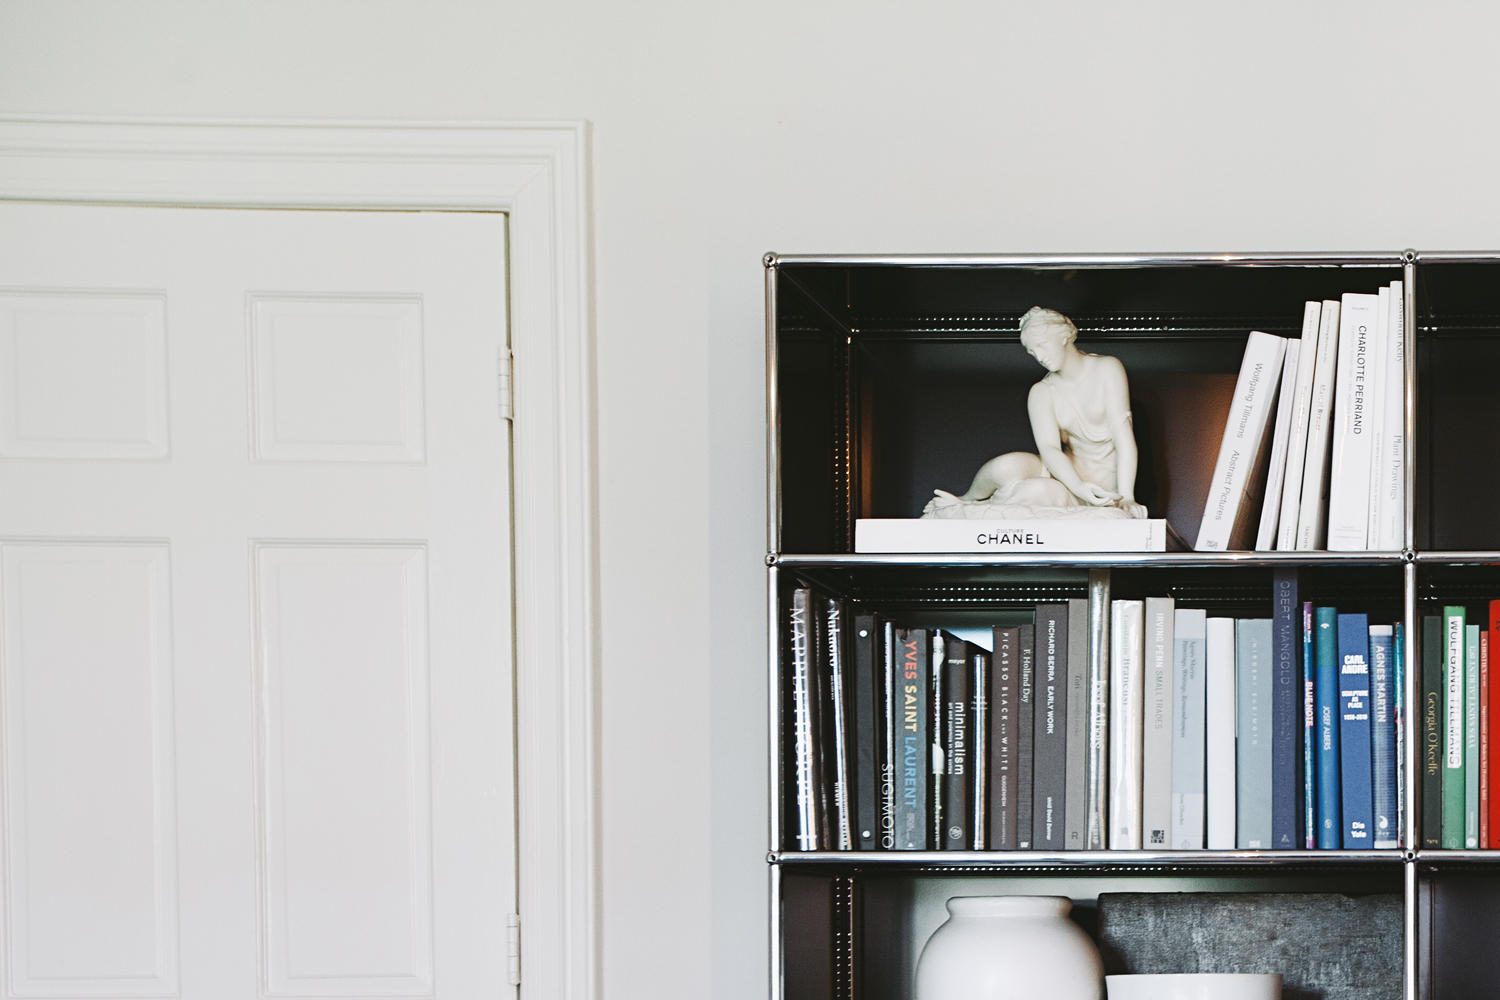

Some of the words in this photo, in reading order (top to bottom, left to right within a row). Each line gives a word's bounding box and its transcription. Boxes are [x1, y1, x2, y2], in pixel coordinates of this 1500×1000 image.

[1356, 326, 1366, 382] CHARLOTTE
[1245, 363, 1264, 402] Wolfgang
[1236, 404, 1253, 438] Tillmans
[1353, 384, 1363, 435] PERRIAND
[1224, 450, 1240, 485] Abstract
[1214, 487, 1231, 521] Pictures
[977, 533, 1045, 545] CHANEL
[1280, 581, 1290, 620] OBERT
[1047, 620, 1055, 654] RICHARD
[1156, 613, 1164, 642] IRVING
[905, 641, 917, 680] YVES
[1023, 656, 1031, 687] Holland
[1047, 655, 1055, 681] SERRA
[1155, 644, 1164, 668] PENN
[1280, 625, 1290, 685] MANGOLD
[1341, 664, 1368, 674] ANDRE
[1344, 655, 1364, 665] CARL
[1376, 646, 1385, 680] AGNES
[1449, 620, 1460, 693] WOLFGANG
[1021, 688, 1030, 703] Day
[1155, 671, 1163, 697] SMALL
[1305, 681, 1313, 702] BLUE
[1468, 661, 1476, 699] LAURENT
[905, 685, 917, 732] SAINT
[1155, 699, 1163, 729] TRADES
[1305, 703, 1313, 726] NOTE
[1323, 706, 1331, 725] JOSEF
[1376, 682, 1386, 723] MARTIN
[1427, 691, 1438, 731] Georgia
[1468, 700, 1476, 726] SAINT
[955, 702, 965, 775] minimalism
[1323, 726, 1332, 750] ALBERS
[1449, 699, 1459, 765] TILLMANS
[1468, 727, 1476, 748] YVES
[904, 737, 917, 808] LAURENT
[881, 763, 894, 849] SUGIMOTO
[1352, 821, 1365, 829] Dia
